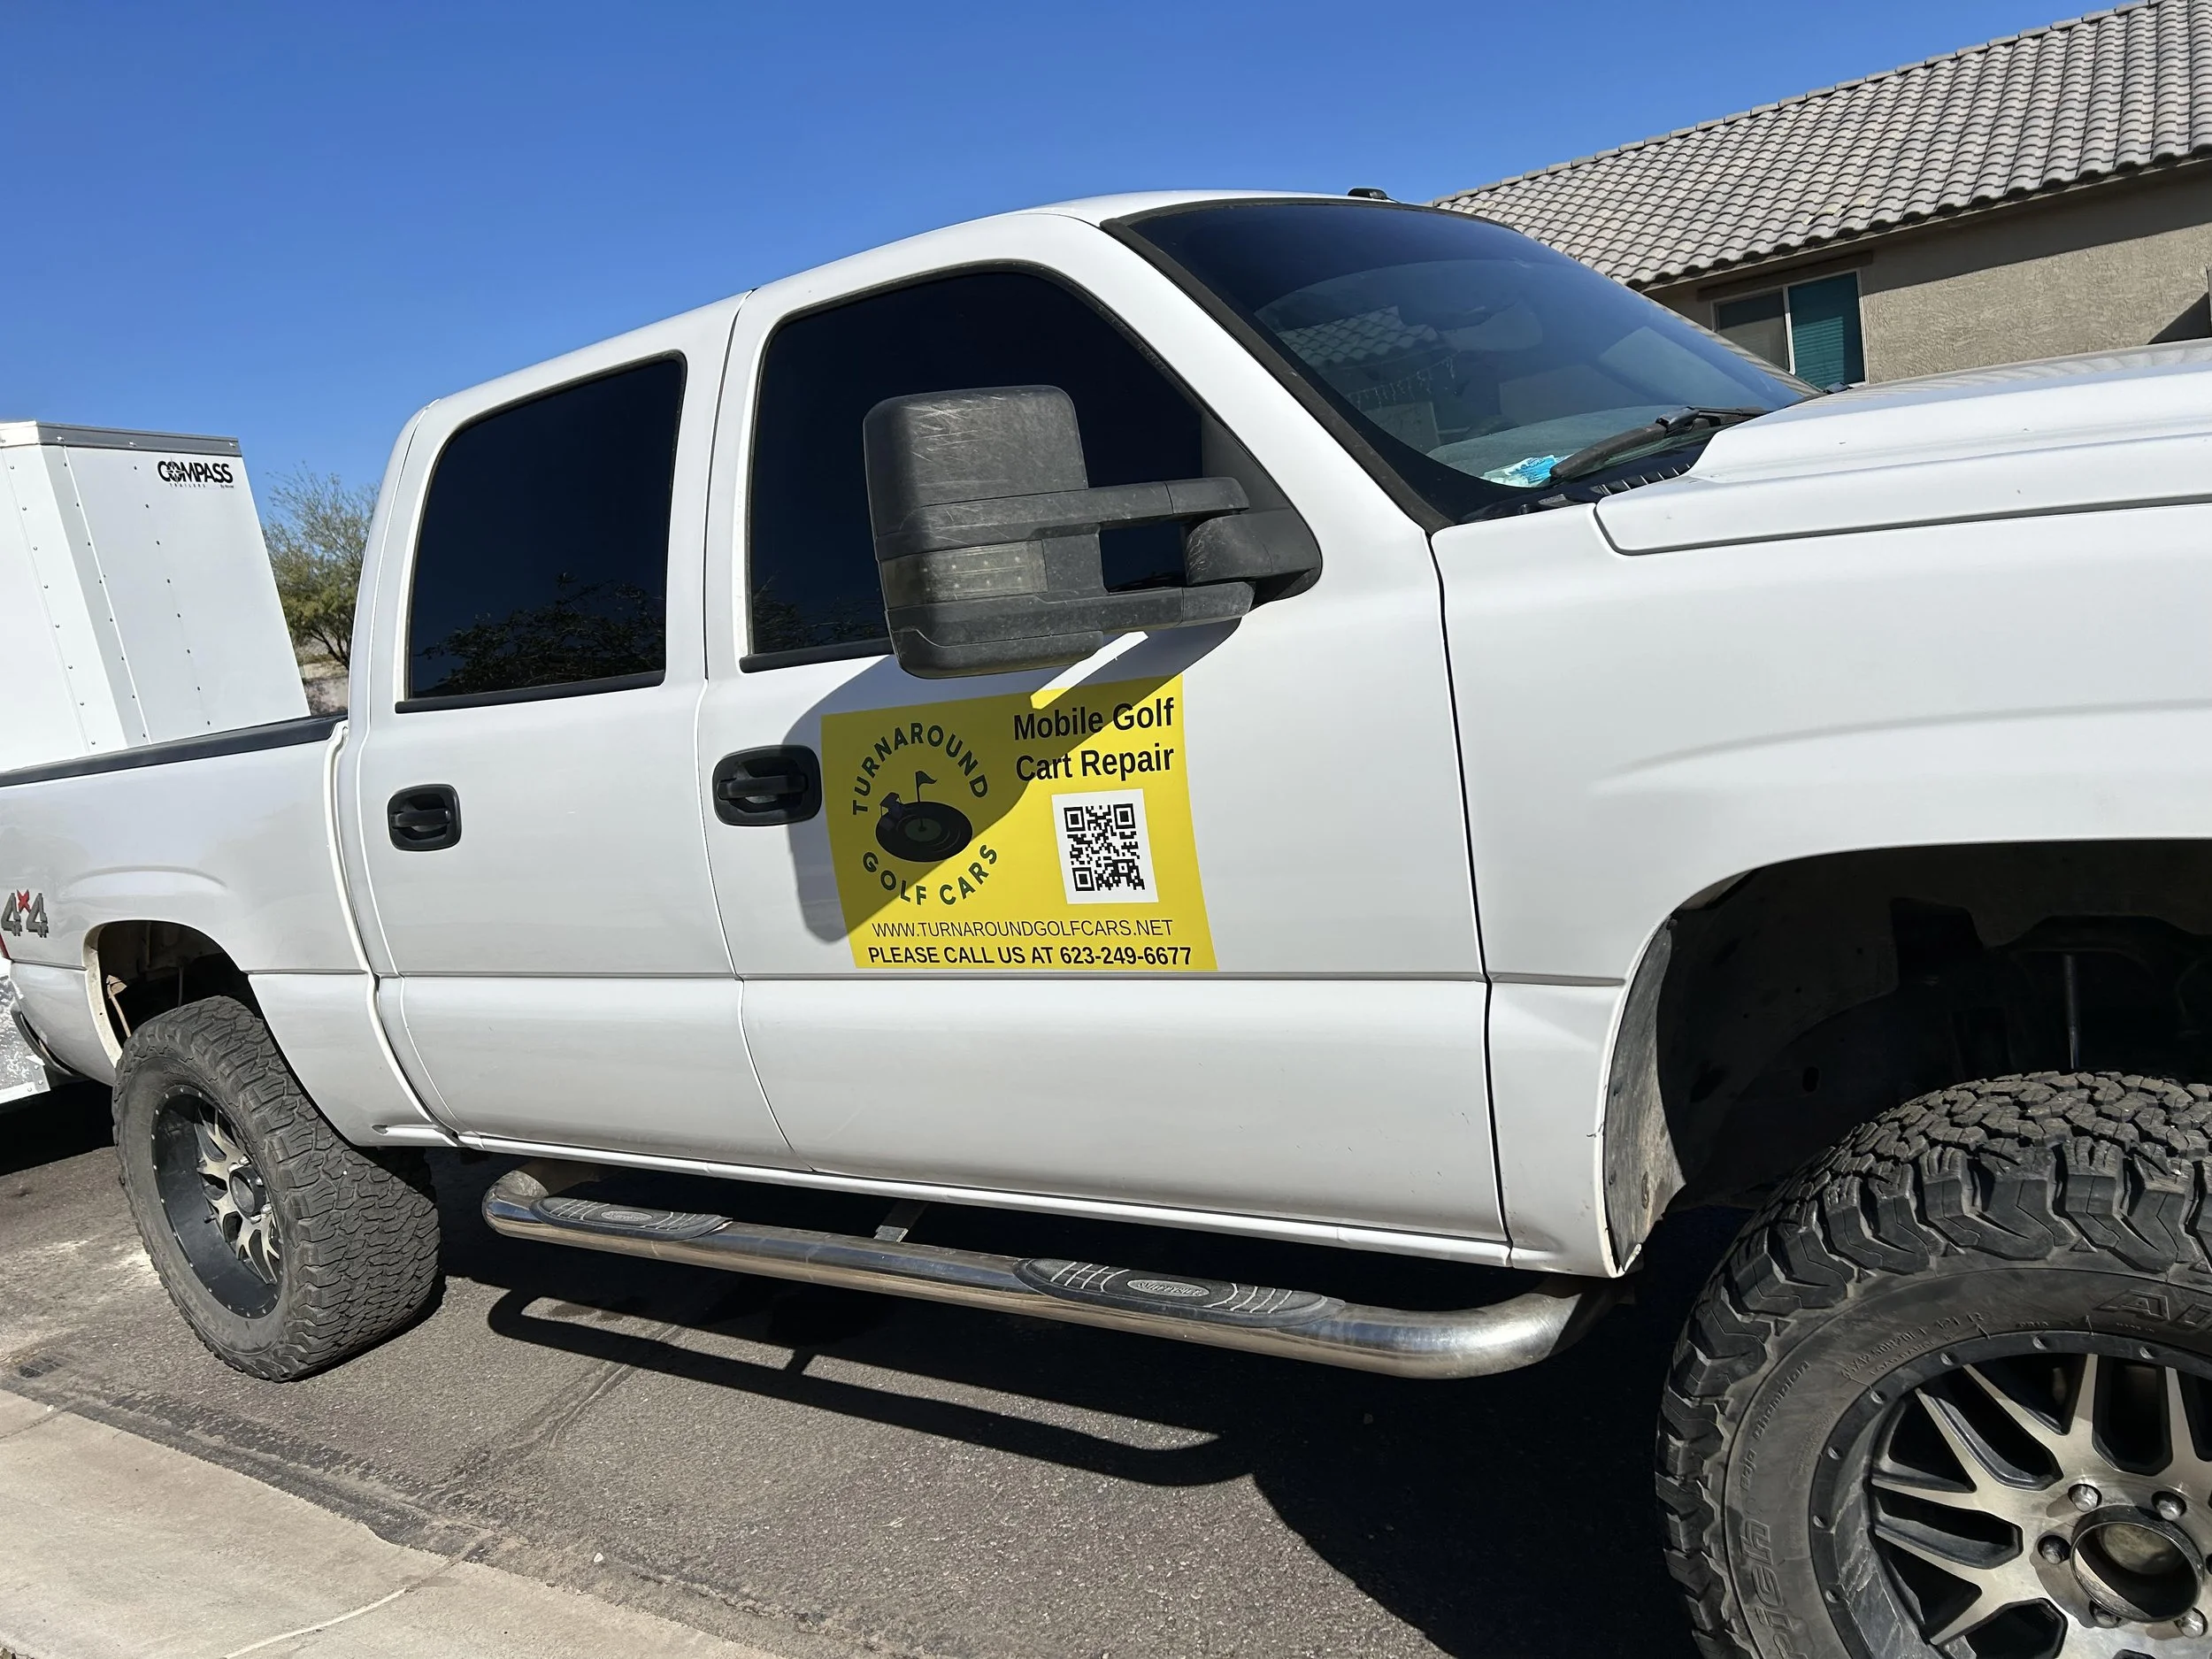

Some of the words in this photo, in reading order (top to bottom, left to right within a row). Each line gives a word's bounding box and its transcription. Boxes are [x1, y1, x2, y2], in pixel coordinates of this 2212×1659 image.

[157, 460, 234, 483] COMPASS
[1013, 707, 1104, 741] Mobile
[1112, 697, 1175, 731] Golf
[852, 722, 988, 816] TURNAROUND
[1016, 754, 1073, 782] Cart
[1081, 743, 1175, 782] Repair
[863, 850, 927, 906] GOLF
[939, 843, 998, 906] CARS
[872, 920, 1172, 937] WWW.TURNAROUNDGOLFCARS.NET
[868, 946, 941, 964] PLEASE
[943, 947, 995, 964] CALL
[997, 947, 1026, 964] US
[1031, 947, 1055, 964] AT
[1060, 946, 1193, 966] 623-249-6677
